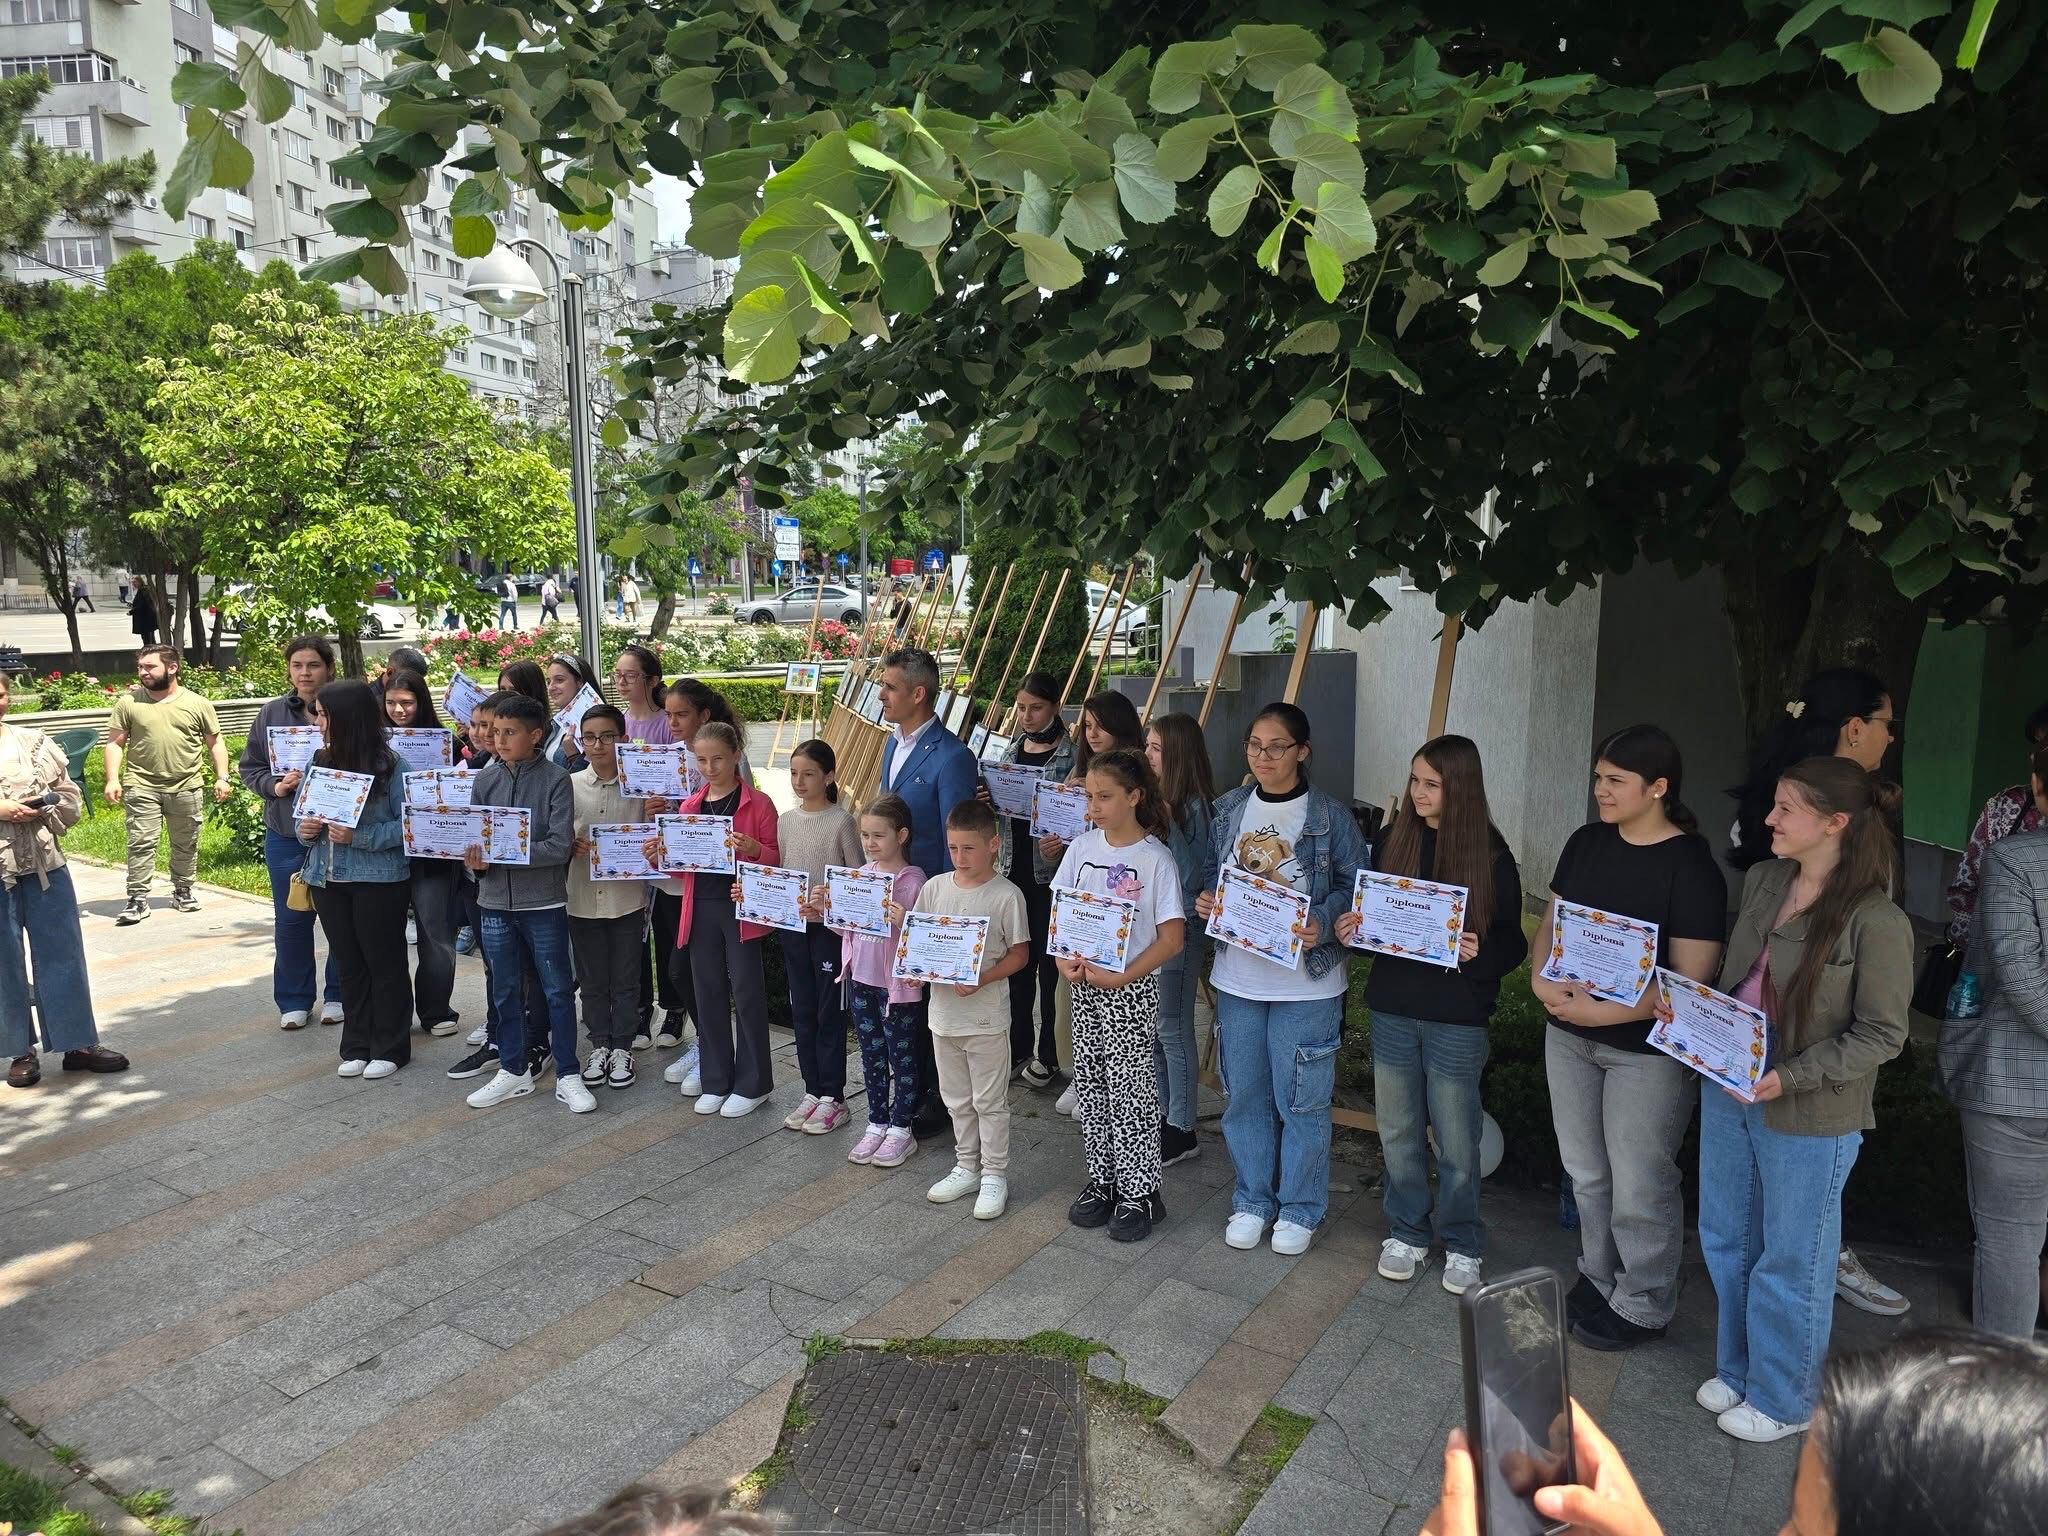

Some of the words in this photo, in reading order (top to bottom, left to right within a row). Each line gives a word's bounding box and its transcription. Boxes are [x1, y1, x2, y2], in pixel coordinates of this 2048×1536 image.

[1242, 892, 1280, 912] Diplomă
[1385, 896, 1431, 911] Diplomă
[1072, 908, 1105, 921] Diplomă
[928, 932, 963, 941] Diplomă
[1582, 929, 1625, 947] Diplomă
[1691, 1001, 1735, 1028] Diplomă
